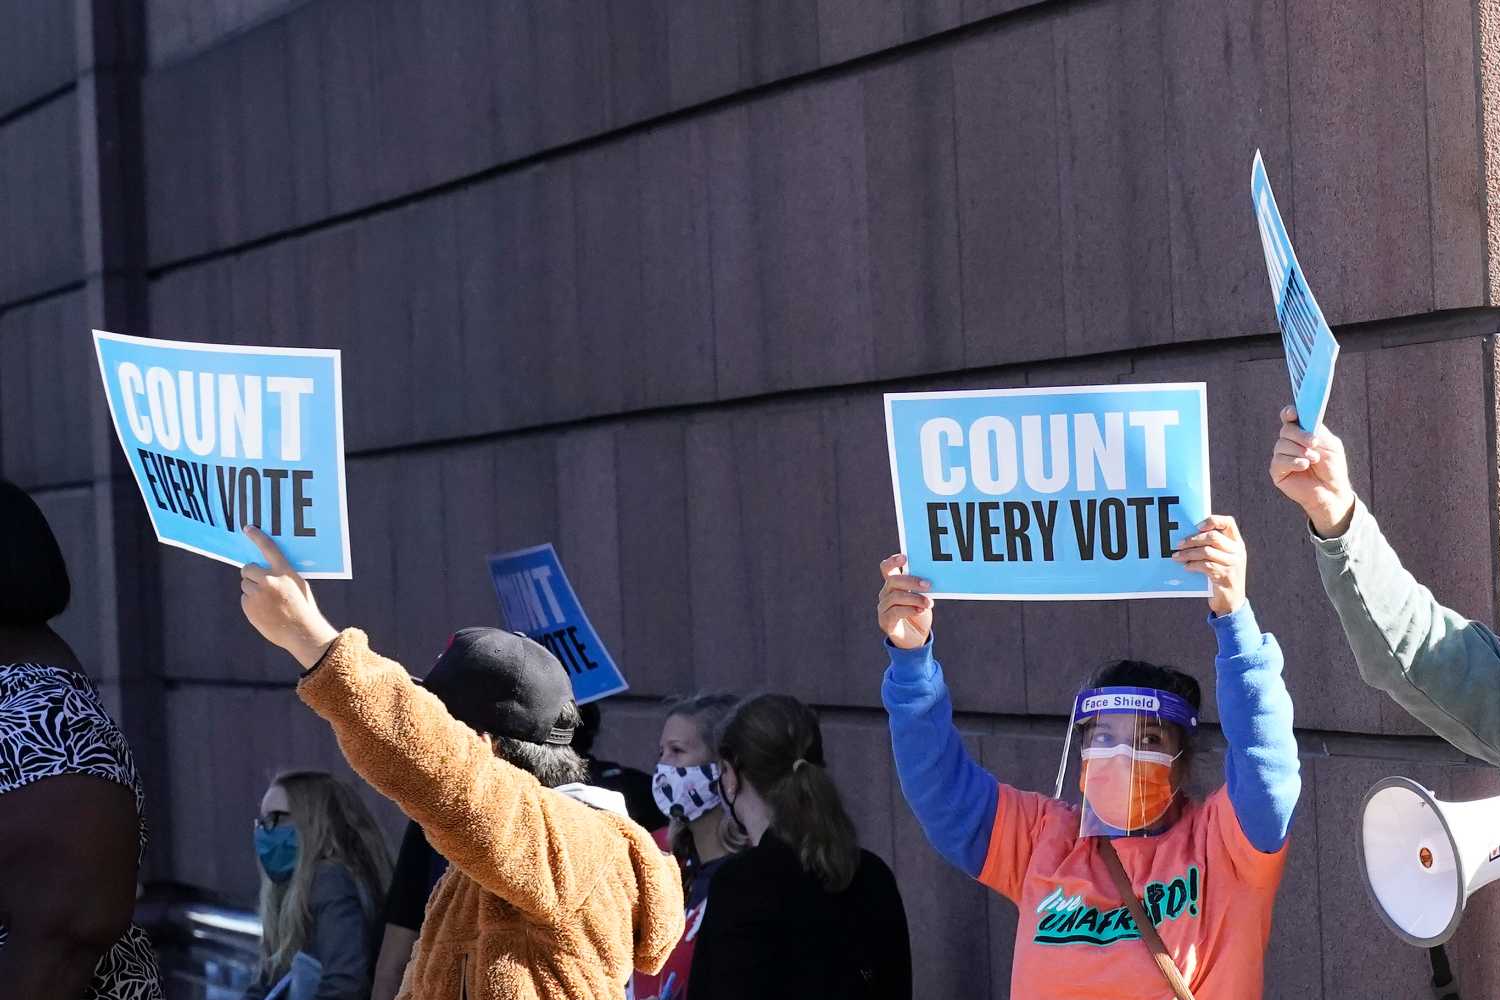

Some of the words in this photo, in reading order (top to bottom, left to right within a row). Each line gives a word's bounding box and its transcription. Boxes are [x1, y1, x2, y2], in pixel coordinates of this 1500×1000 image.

[117, 361, 314, 461] COUNT
[919, 410, 1180, 496] COUNT
[137, 448, 215, 527] EVERY
[215, 465, 316, 537] VOTE
[926, 499, 1058, 562] EVERY
[1069, 496, 1180, 561] VOTE
[1085, 699, 1109, 710] Face
[1114, 696, 1154, 708] Shield
